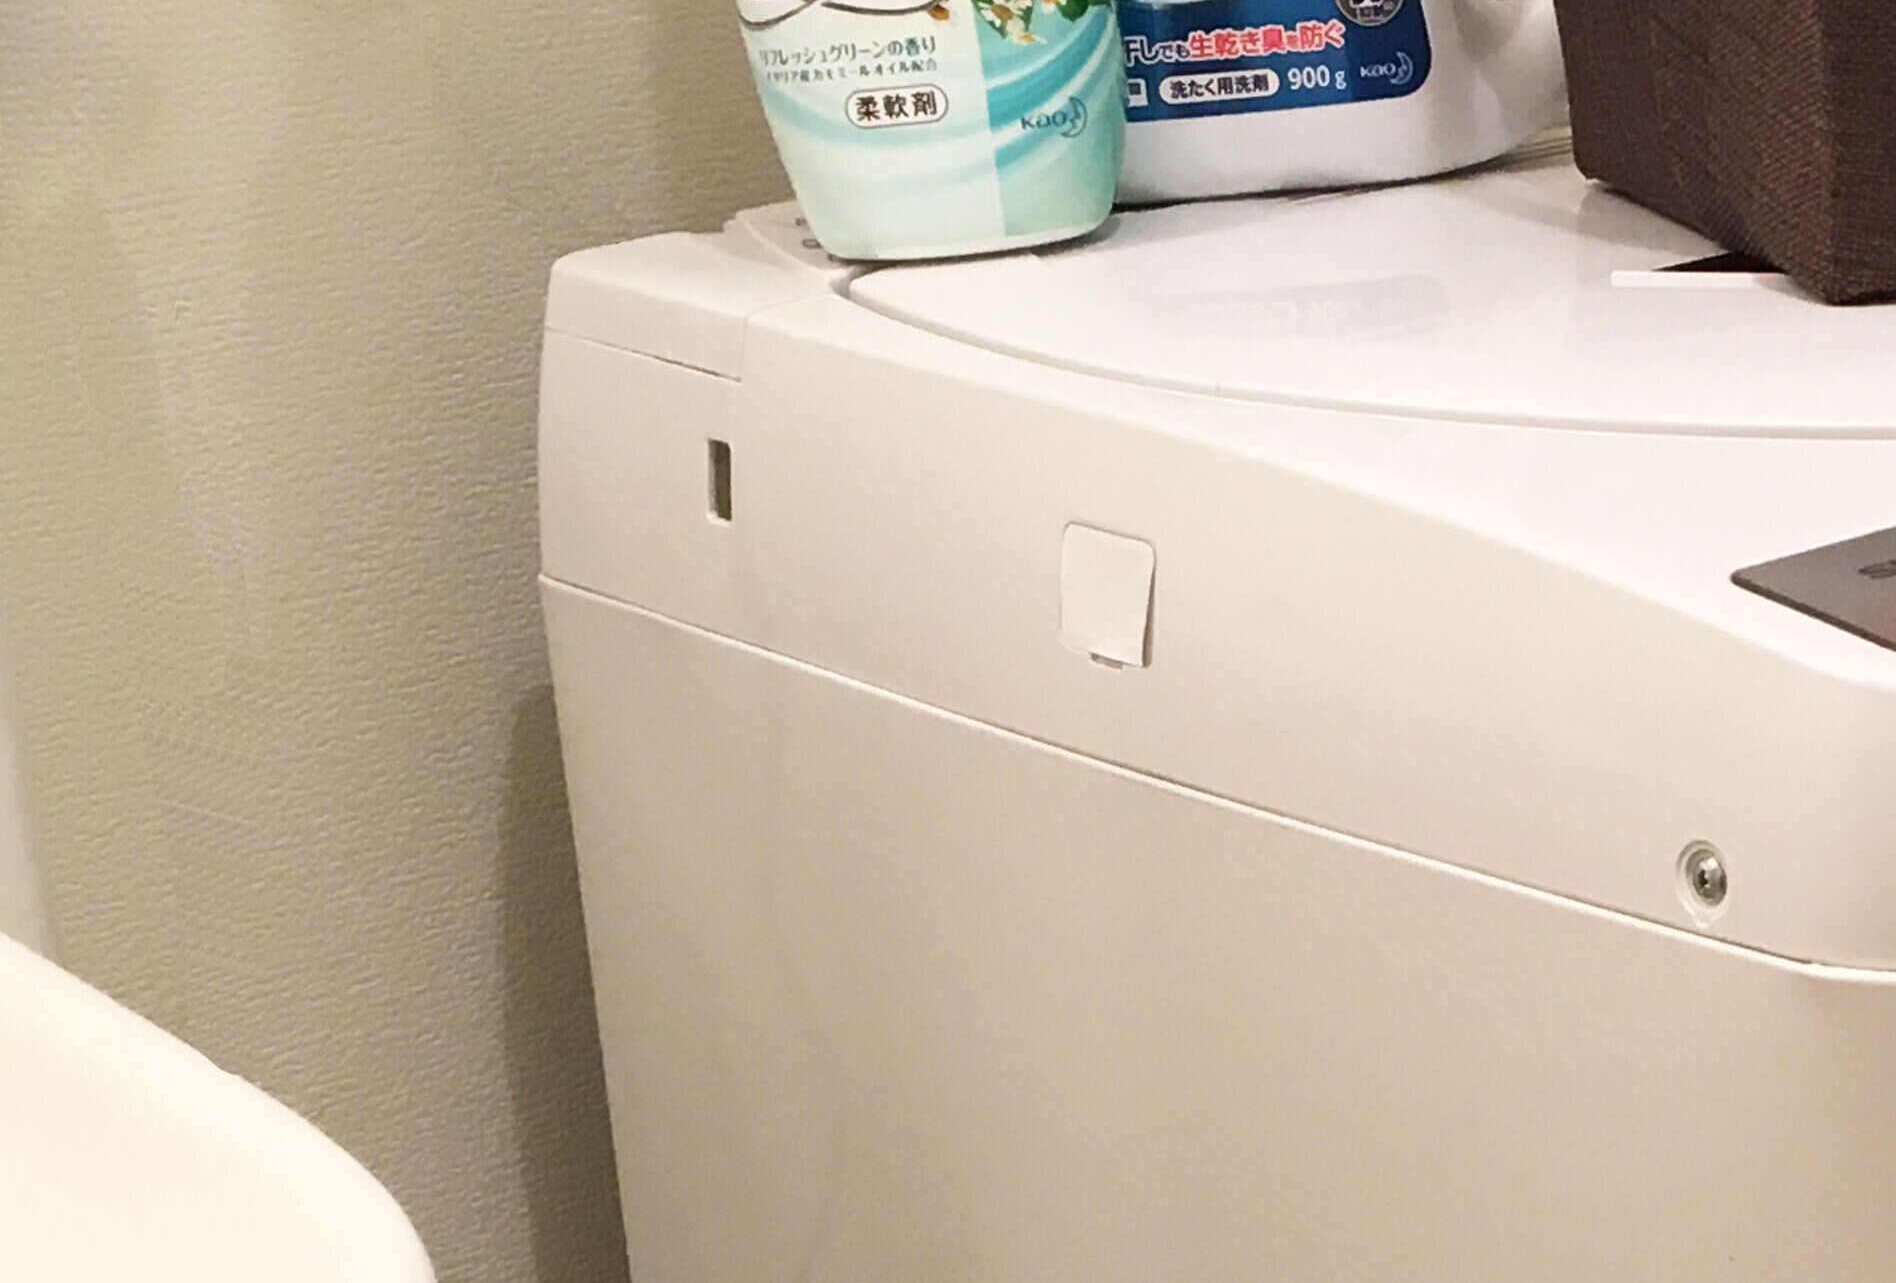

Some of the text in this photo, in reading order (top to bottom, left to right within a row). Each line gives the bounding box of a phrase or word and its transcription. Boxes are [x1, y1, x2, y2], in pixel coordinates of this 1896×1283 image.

[1169, 74, 1271, 100] 洗たく用洗剤
[855, 90, 939, 122] 柔軟剤
